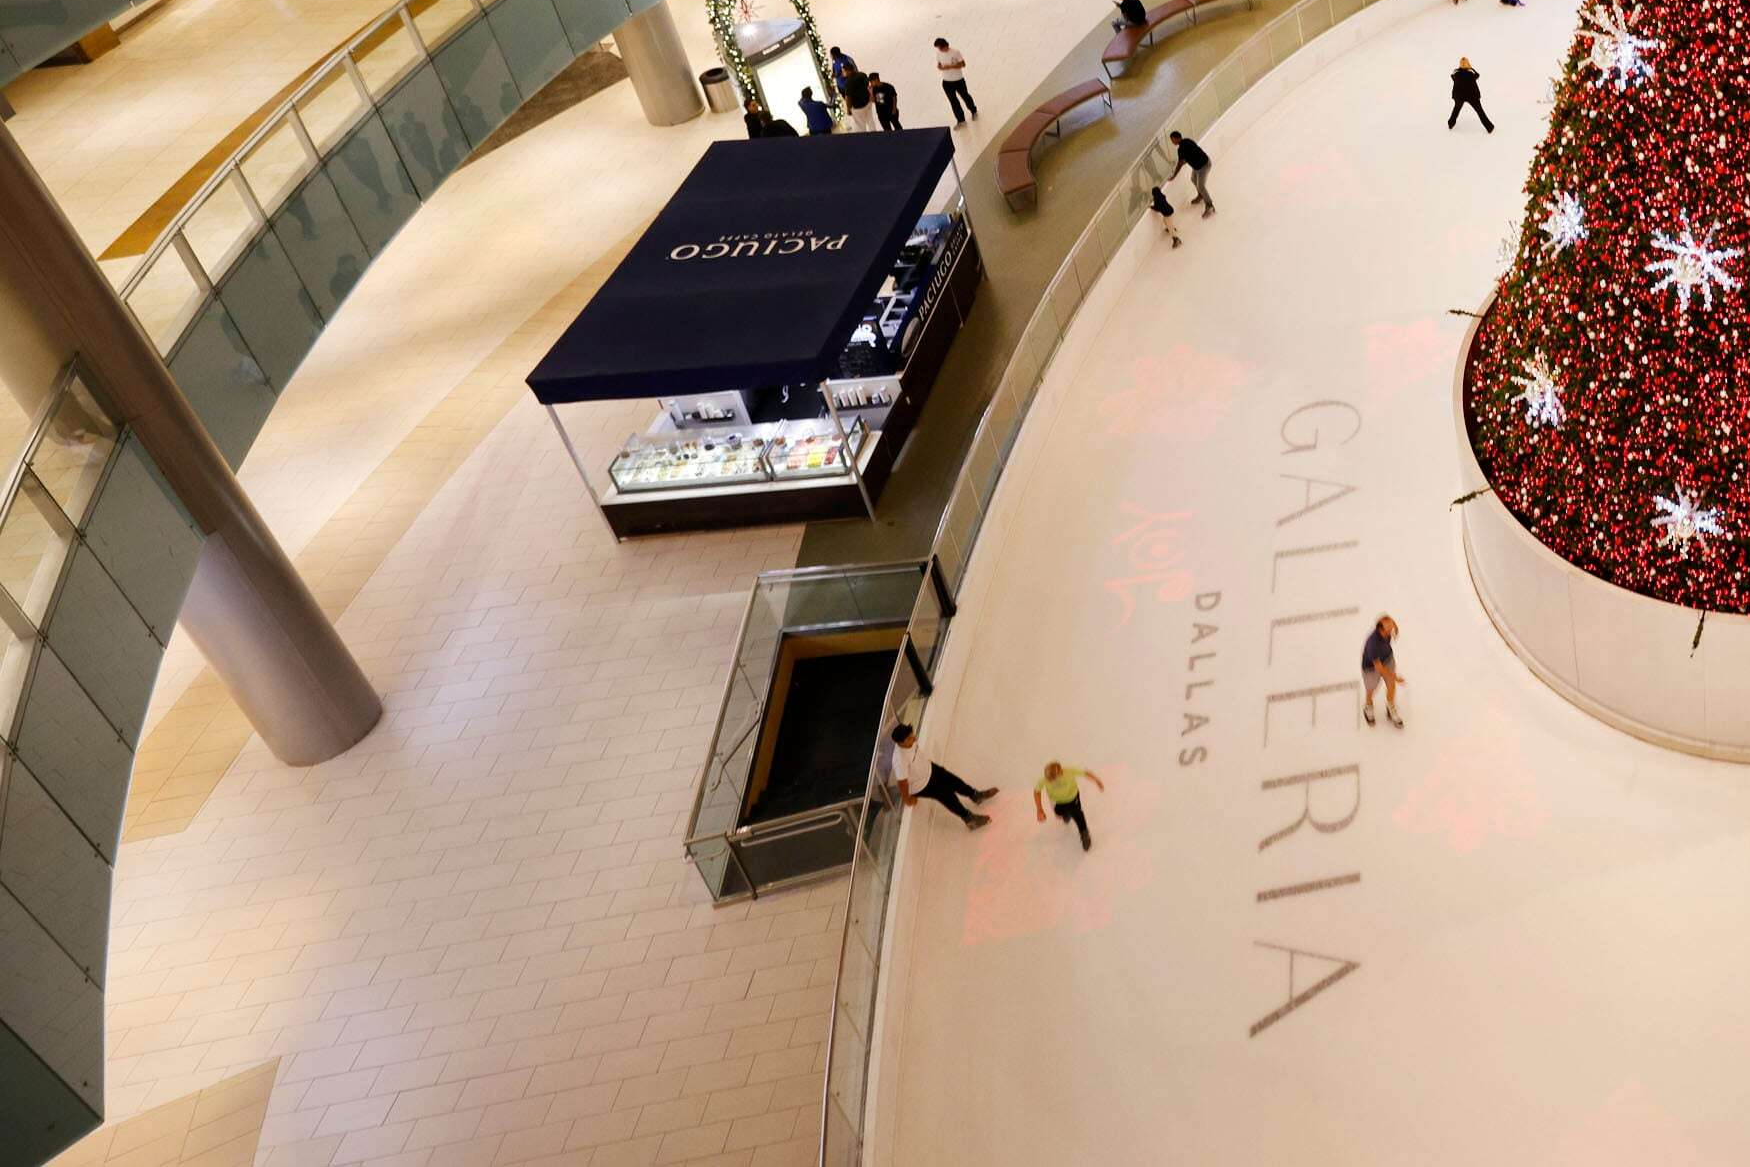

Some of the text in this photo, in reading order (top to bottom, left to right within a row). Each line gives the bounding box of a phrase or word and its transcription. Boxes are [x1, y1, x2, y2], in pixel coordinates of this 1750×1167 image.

[668, 233, 850, 262] PACIUGO
[918, 250, 952, 322] PACIUGO
[1177, 590, 1223, 768] DALLAS
[1248, 398, 1362, 1039] GALLERIA
